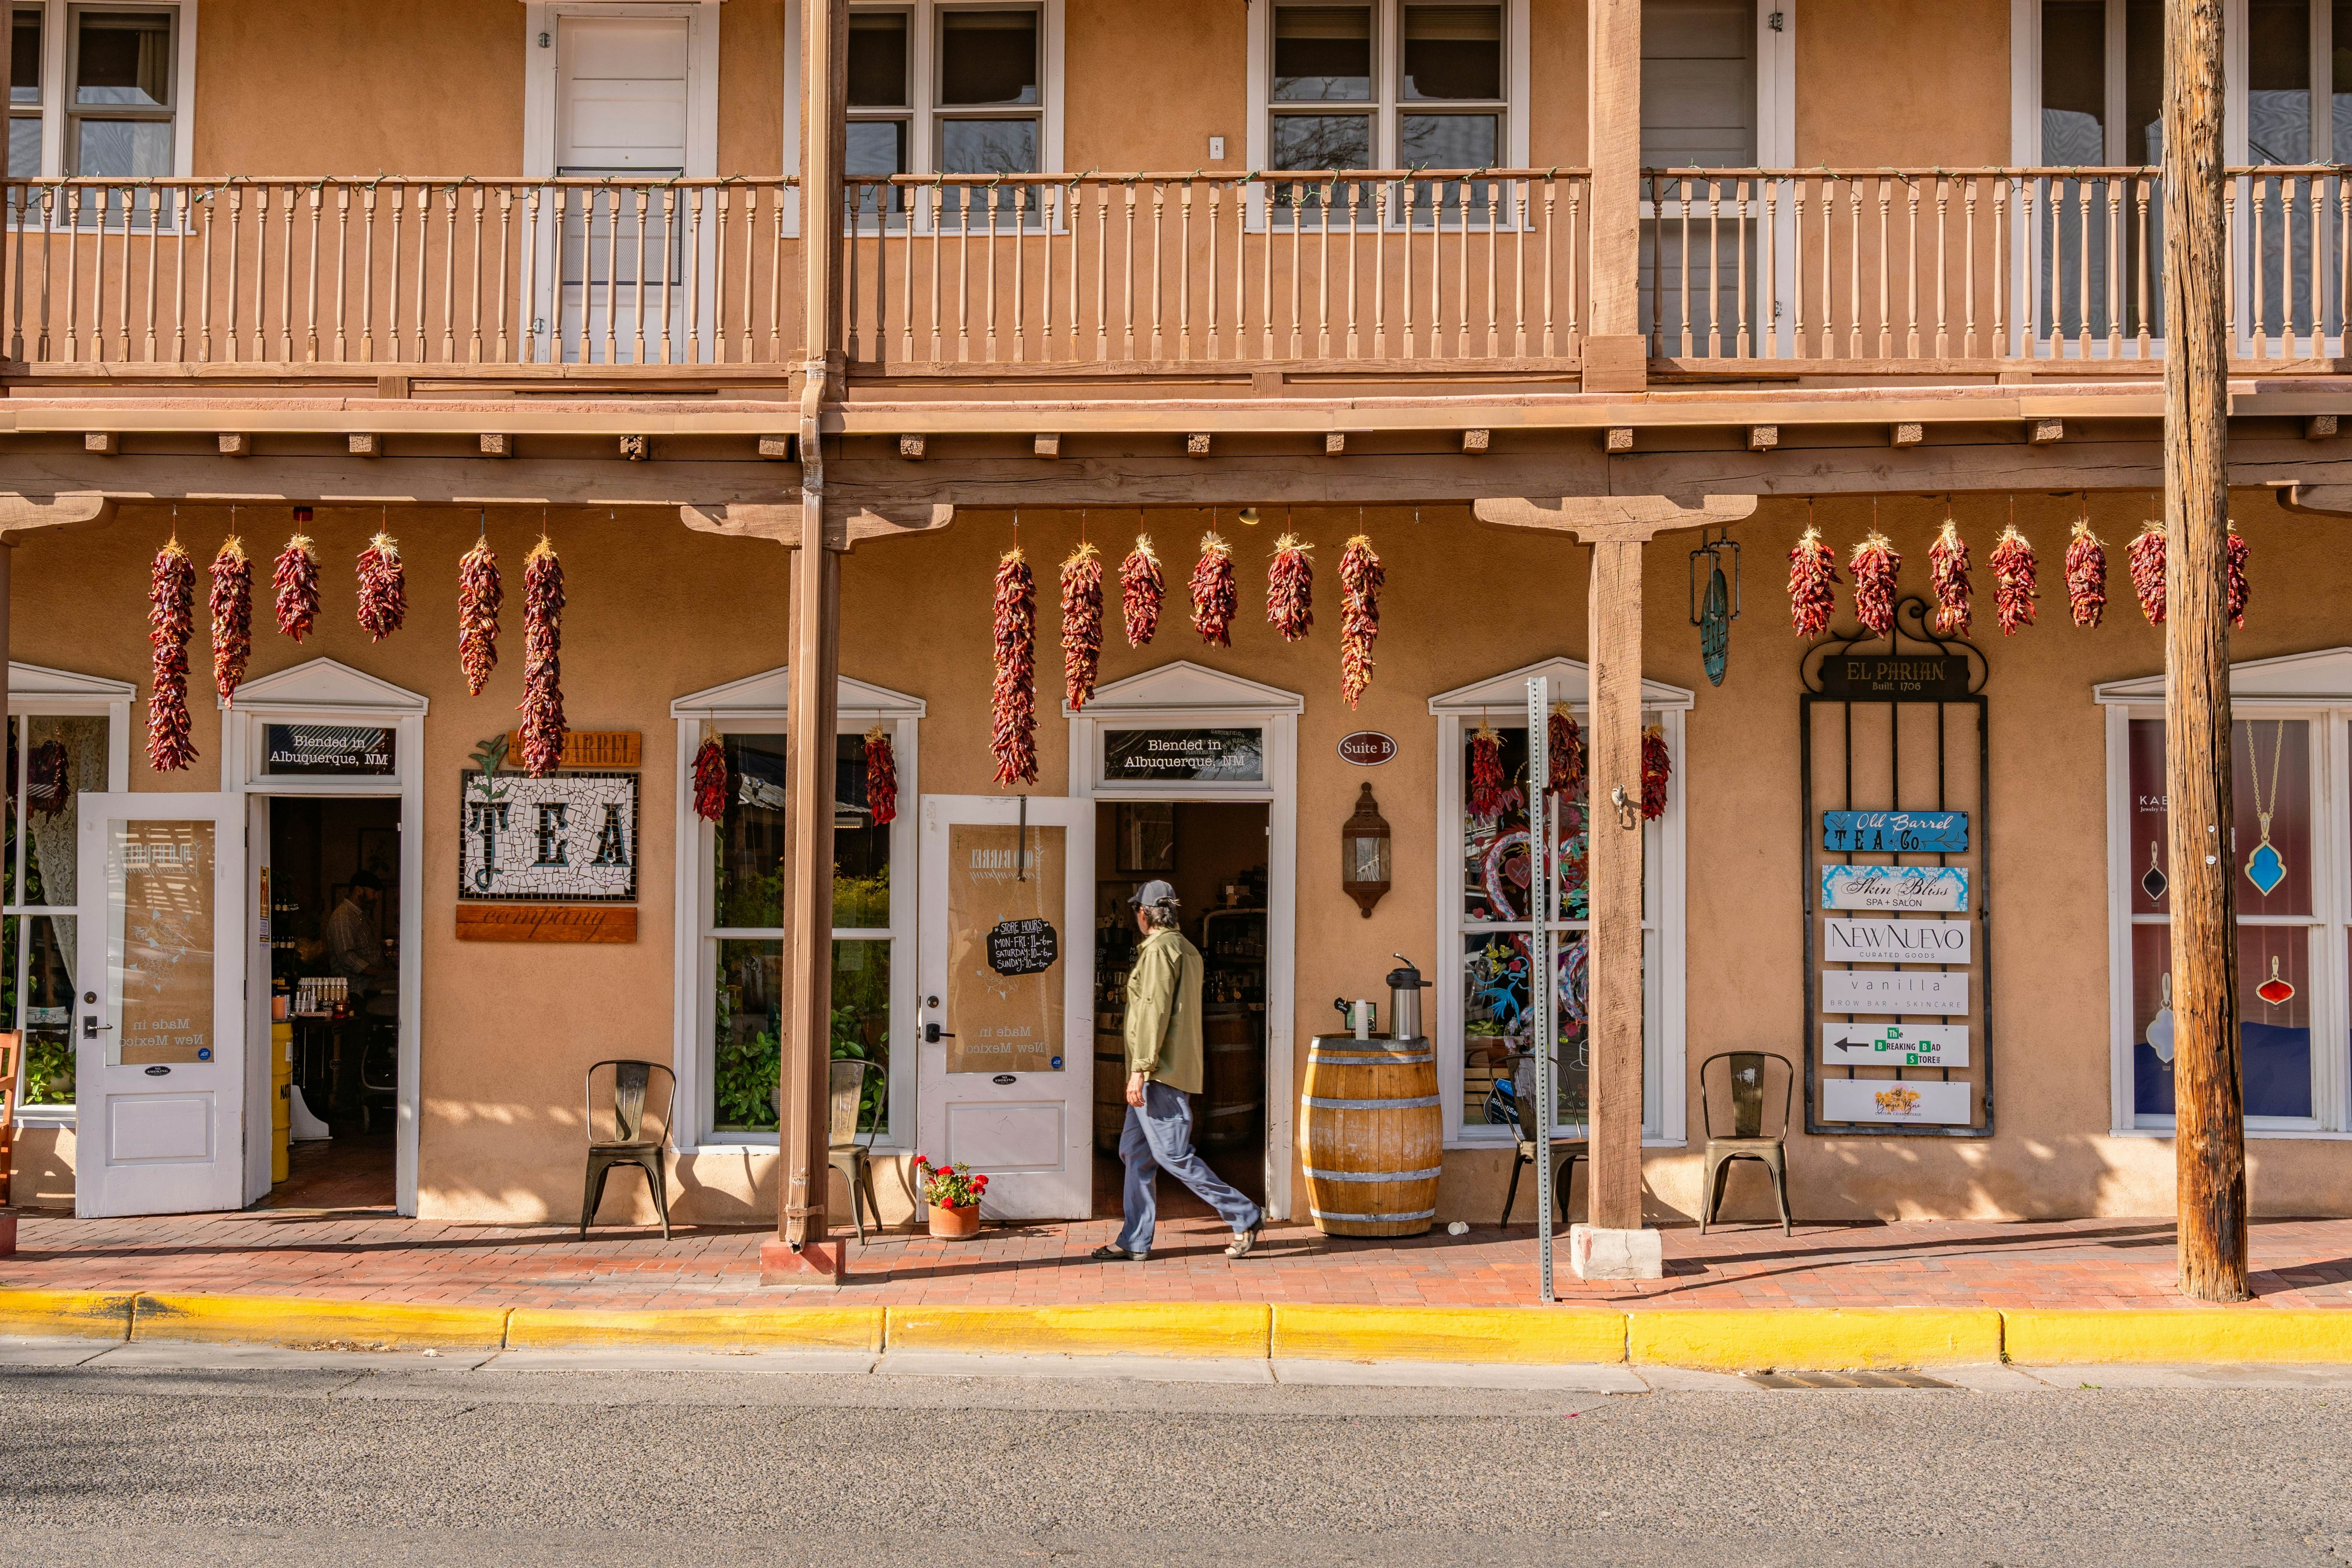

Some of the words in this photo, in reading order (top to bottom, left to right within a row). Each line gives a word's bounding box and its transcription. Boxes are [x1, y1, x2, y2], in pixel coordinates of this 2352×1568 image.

[1847, 662, 1872, 679] EL
[1877, 660, 1946, 680] PARIAN
[1900, 682, 1921, 692] 1706
[294, 735, 348, 748] Blended
[352, 737, 366, 748] in
[1148, 740, 1203, 751] Blended
[1208, 739, 1222, 750] in
[1344, 742, 1377, 753] Suite
[1381, 742, 1390, 753] B
[269, 751, 359, 767] Albuquerque,
[364, 754, 388, 765] NM
[1124, 757, 1216, 769] Albuquerque,
[1222, 755, 1245, 766] NM
[1857, 813, 1887, 829] Old
[1890, 814, 1954, 835] Barrel
[468, 802, 630, 892] TEA
[1835, 830, 1884, 850] TEA
[1841, 875, 1892, 895] Skin
[1894, 875, 1948, 899] Bliss
[483, 908, 607, 942] company
[1000, 922, 1019, 934] STORE
[1021, 919, 1042, 933] HOURS
[1851, 979, 1940, 991] vanilla
[1877, 1042, 1916, 1051] BREAKING
[1910, 1055, 1936, 1063] STORE
